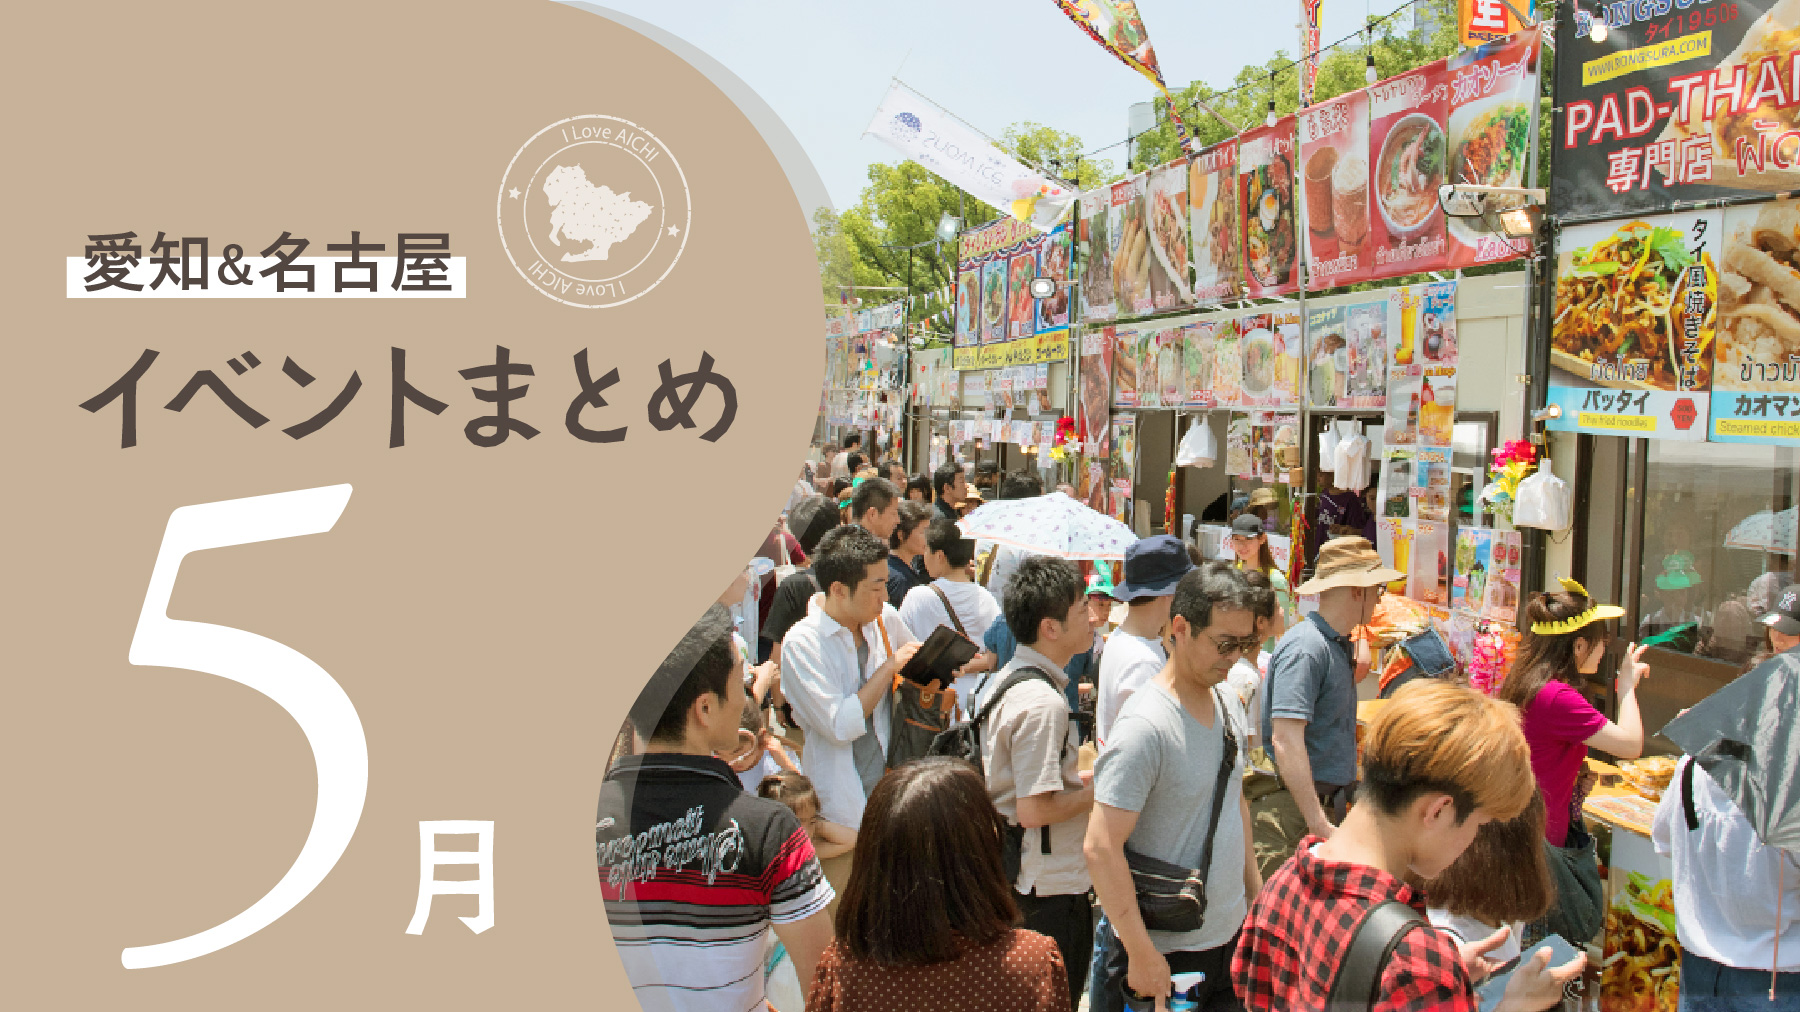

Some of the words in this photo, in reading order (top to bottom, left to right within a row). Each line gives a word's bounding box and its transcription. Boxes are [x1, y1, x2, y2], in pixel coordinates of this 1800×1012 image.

[1451, 46, 1532, 105] カオソーイ
[1605, 132, 1712, 194] 専門店
[1679, 217, 1709, 391] タイ風焼きそば
[1582, 390, 1650, 415] パッタイ
[1600, 415, 1615, 426] fried
[1617, 417, 1648, 428] noodles
[1720, 420, 1767, 434] Steamed
